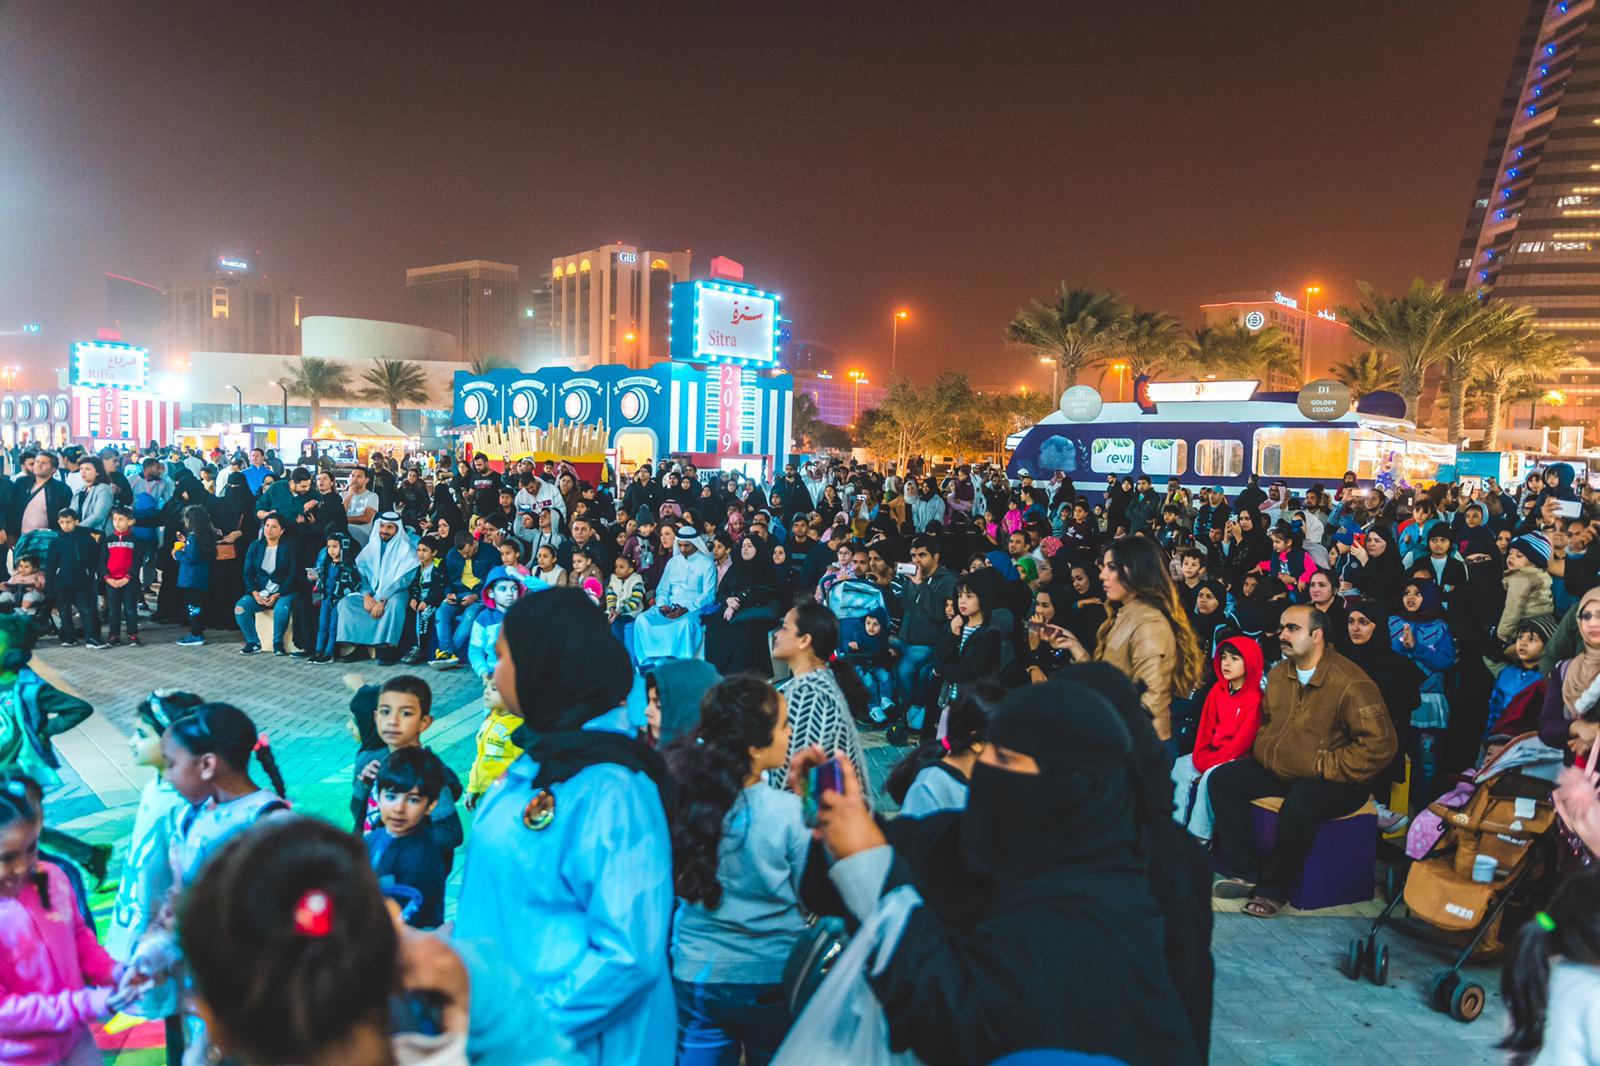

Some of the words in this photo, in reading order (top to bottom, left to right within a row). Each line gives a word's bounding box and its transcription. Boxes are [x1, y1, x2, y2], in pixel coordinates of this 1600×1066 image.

[620, 251, 636, 263] GIB
[731, 301, 763, 325] سترة
[708, 330, 737, 347] Sitra
[88, 368, 114, 379] Riffa
[722, 366, 733, 452] 2019
